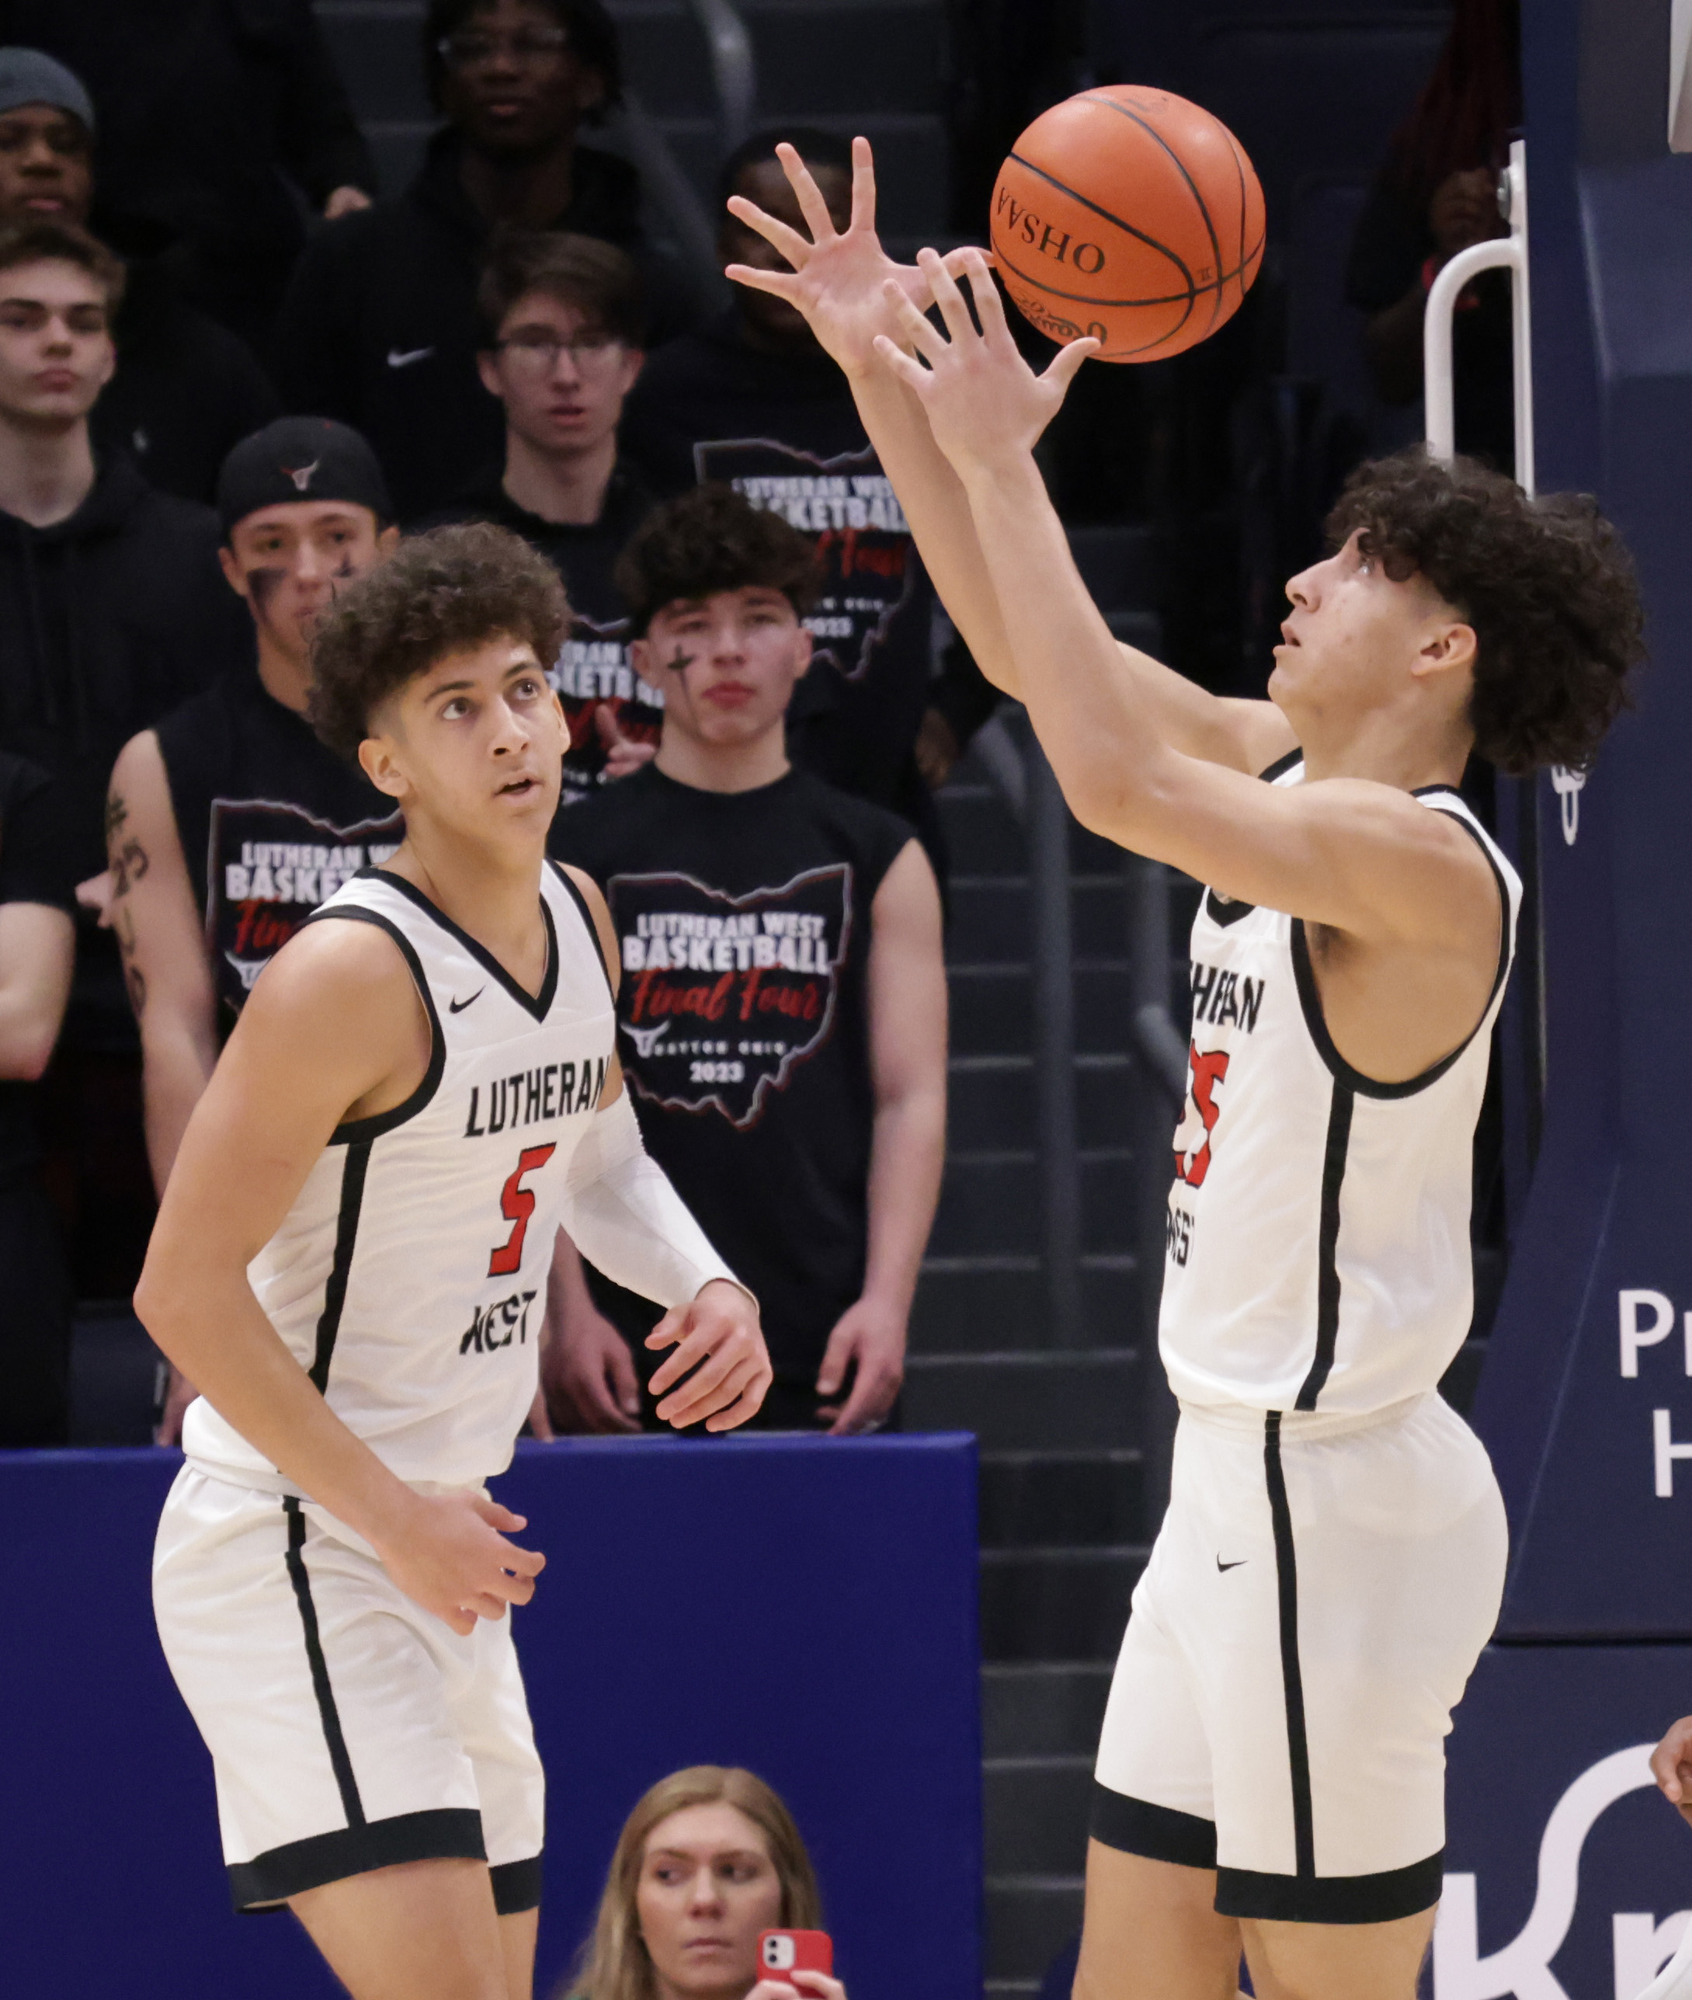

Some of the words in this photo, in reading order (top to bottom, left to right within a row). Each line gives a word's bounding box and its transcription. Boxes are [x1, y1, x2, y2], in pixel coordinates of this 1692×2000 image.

[241, 841, 364, 869] LUTHERAN
[637, 912, 757, 938] LUTHERAN
[762, 911, 826, 939] WEST
[622, 934, 829, 976] BASKETBALL
[631, 964, 736, 1024] Final
[739, 961, 818, 1022] Four
[689, 1061, 745, 1083] 2023
[463, 1054, 611, 1138] LUTHERAN
[486, 1141, 558, 1279] 5
